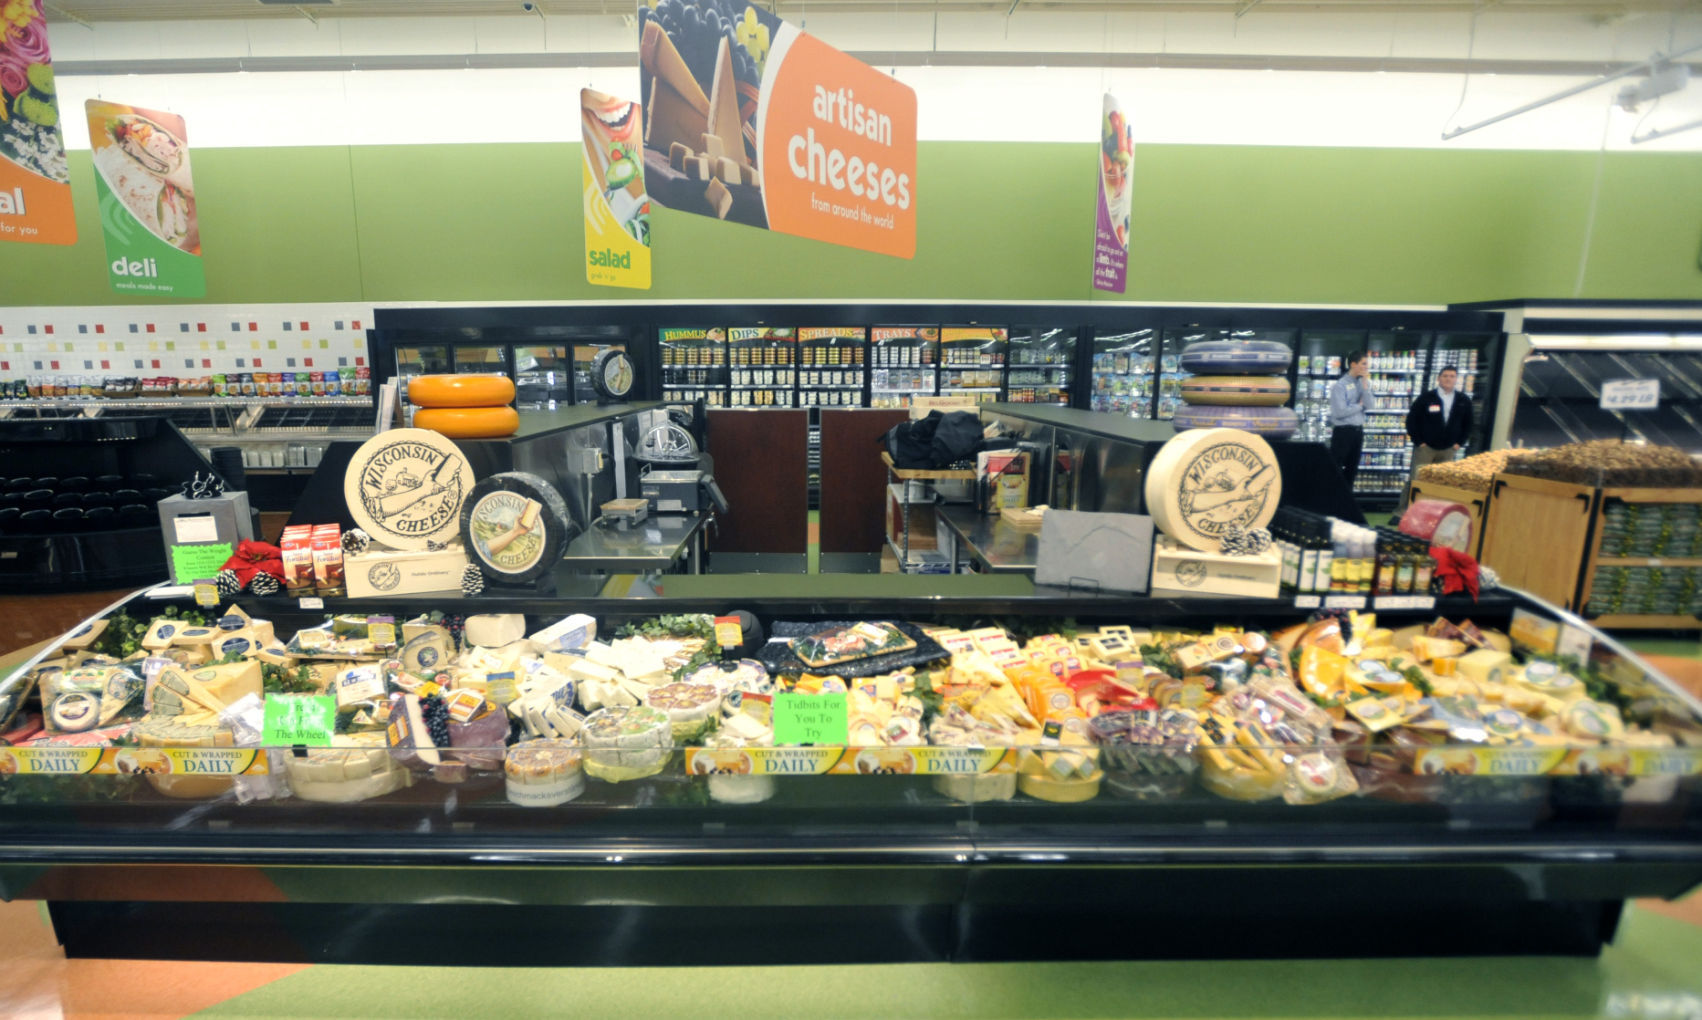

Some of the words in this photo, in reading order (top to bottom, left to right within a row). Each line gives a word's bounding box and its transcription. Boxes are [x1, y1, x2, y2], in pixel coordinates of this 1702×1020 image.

[813, 85, 891, 146] artisan
[787, 127, 910, 210] cheeses
[811, 191, 831, 213] from
[832, 203, 859, 221] around
[861, 205, 872, 224] the
[873, 212, 894, 231] world
[0, 222, 15, 232] for
[20, 226, 38, 236] you
[589, 248, 631, 269] salad
[112, 256, 157, 278] deli
[137, 282, 156, 290] made
[664, 329, 707, 341] HUMMUS
[731, 328, 760, 340] DIPS
[799, 328, 852, 341] SPREADS
[875, 329, 912, 340] TRAYS
[365, 445, 439, 491] WISCONSIN
[1189, 446, 1256, 483] WISCONSIN
[396, 495, 455, 533] CHEESE
[475, 495, 525, 533] WISCONSIN
[500, 534, 537, 564] CHEESE
[787, 700, 820, 710] Tidbits
[824, 700, 841, 710] For
[795, 714, 816, 724] You
[819, 714, 833, 724] To
[275, 729, 293, 739] The
[296, 729, 326, 739] Wheel
[805, 727, 822, 739] Try
[30, 759, 80, 771] DAILY
[183, 760, 234, 772] DAILY
[765, 759, 818, 772] DAILY
[928, 759, 981, 771] DAILY
[1490, 760, 1541, 773] DAILY
